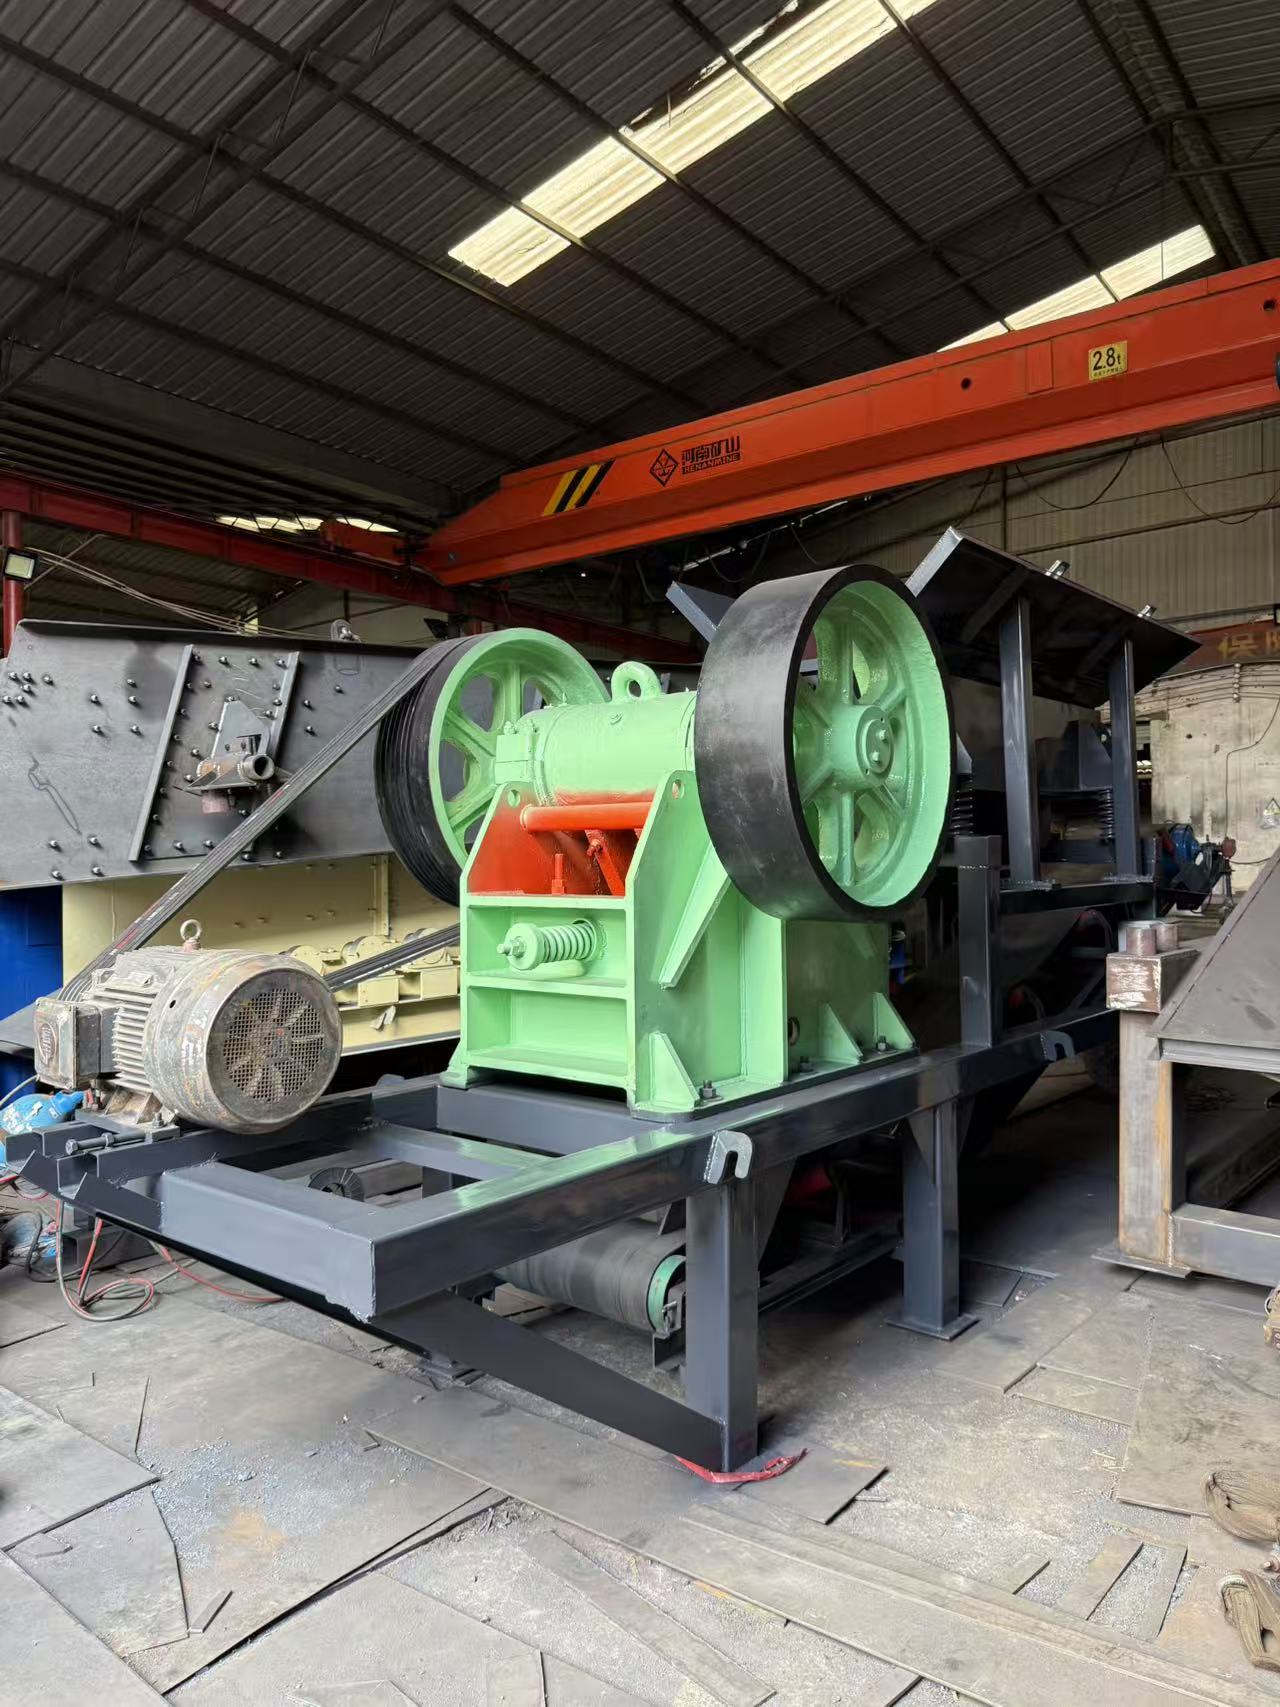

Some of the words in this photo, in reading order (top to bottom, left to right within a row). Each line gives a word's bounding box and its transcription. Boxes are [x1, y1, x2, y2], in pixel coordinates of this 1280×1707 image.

[1093, 347, 1121, 371] 2.8t
[682, 435, 740, 464] 河南矿山
